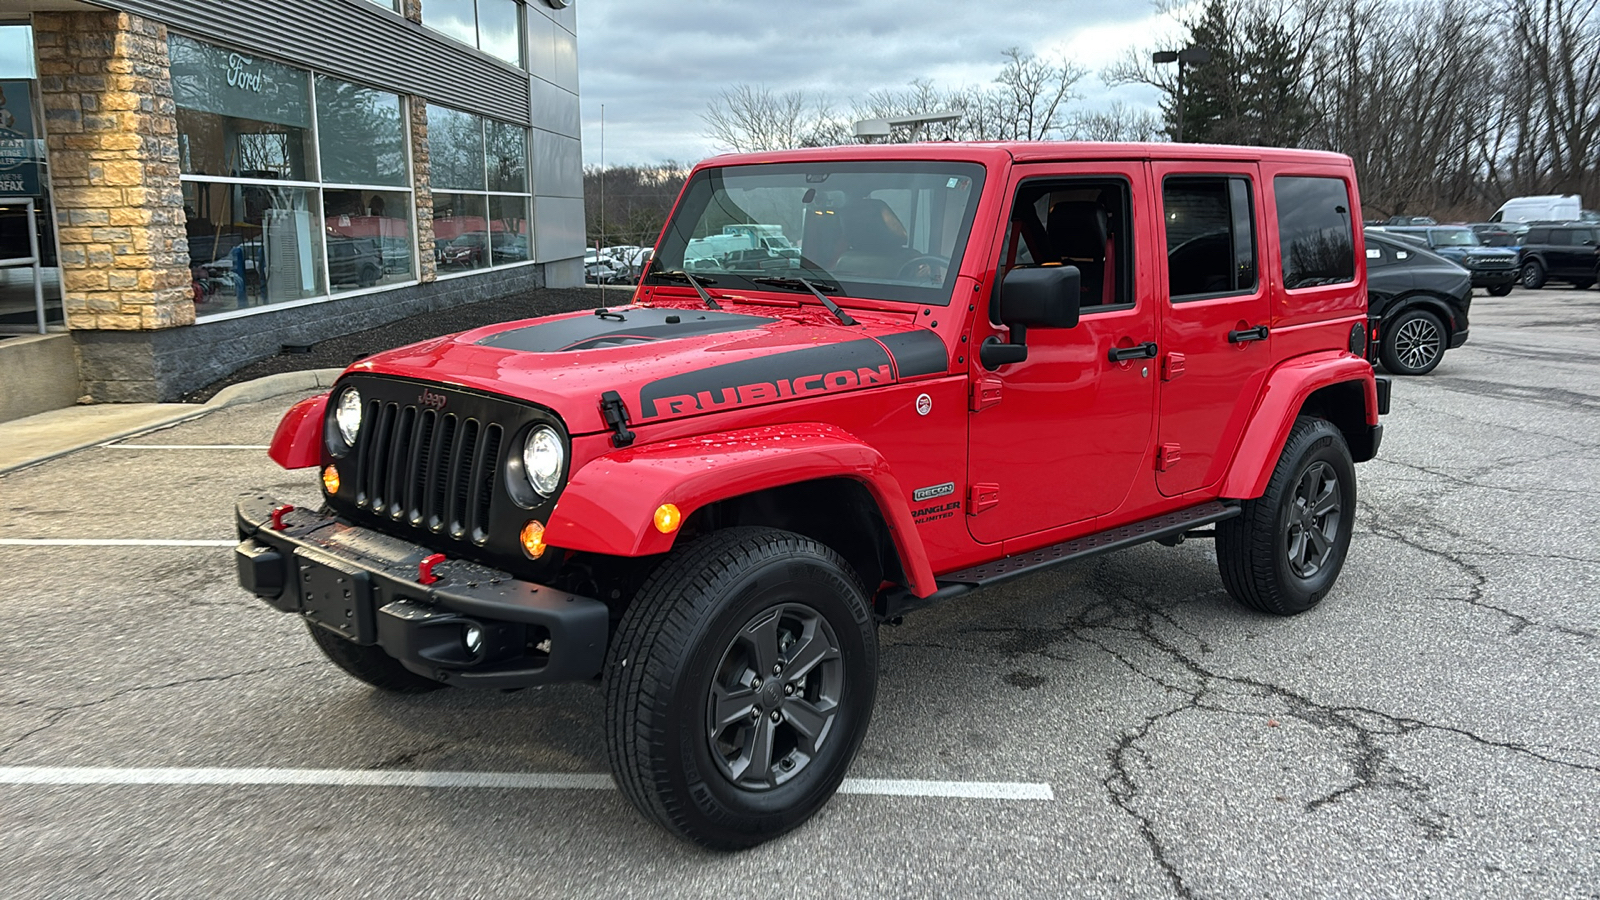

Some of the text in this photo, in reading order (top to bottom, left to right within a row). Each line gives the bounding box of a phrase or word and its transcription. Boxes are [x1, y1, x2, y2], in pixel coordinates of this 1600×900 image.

[227, 53, 262, 92] Ford
[418, 388, 447, 410] Jeep
[652, 364, 896, 417] RUBICON
[917, 485, 952, 498] RECON
[911, 501, 961, 517] RANGLER
[915, 511, 954, 525] NLIMITED
